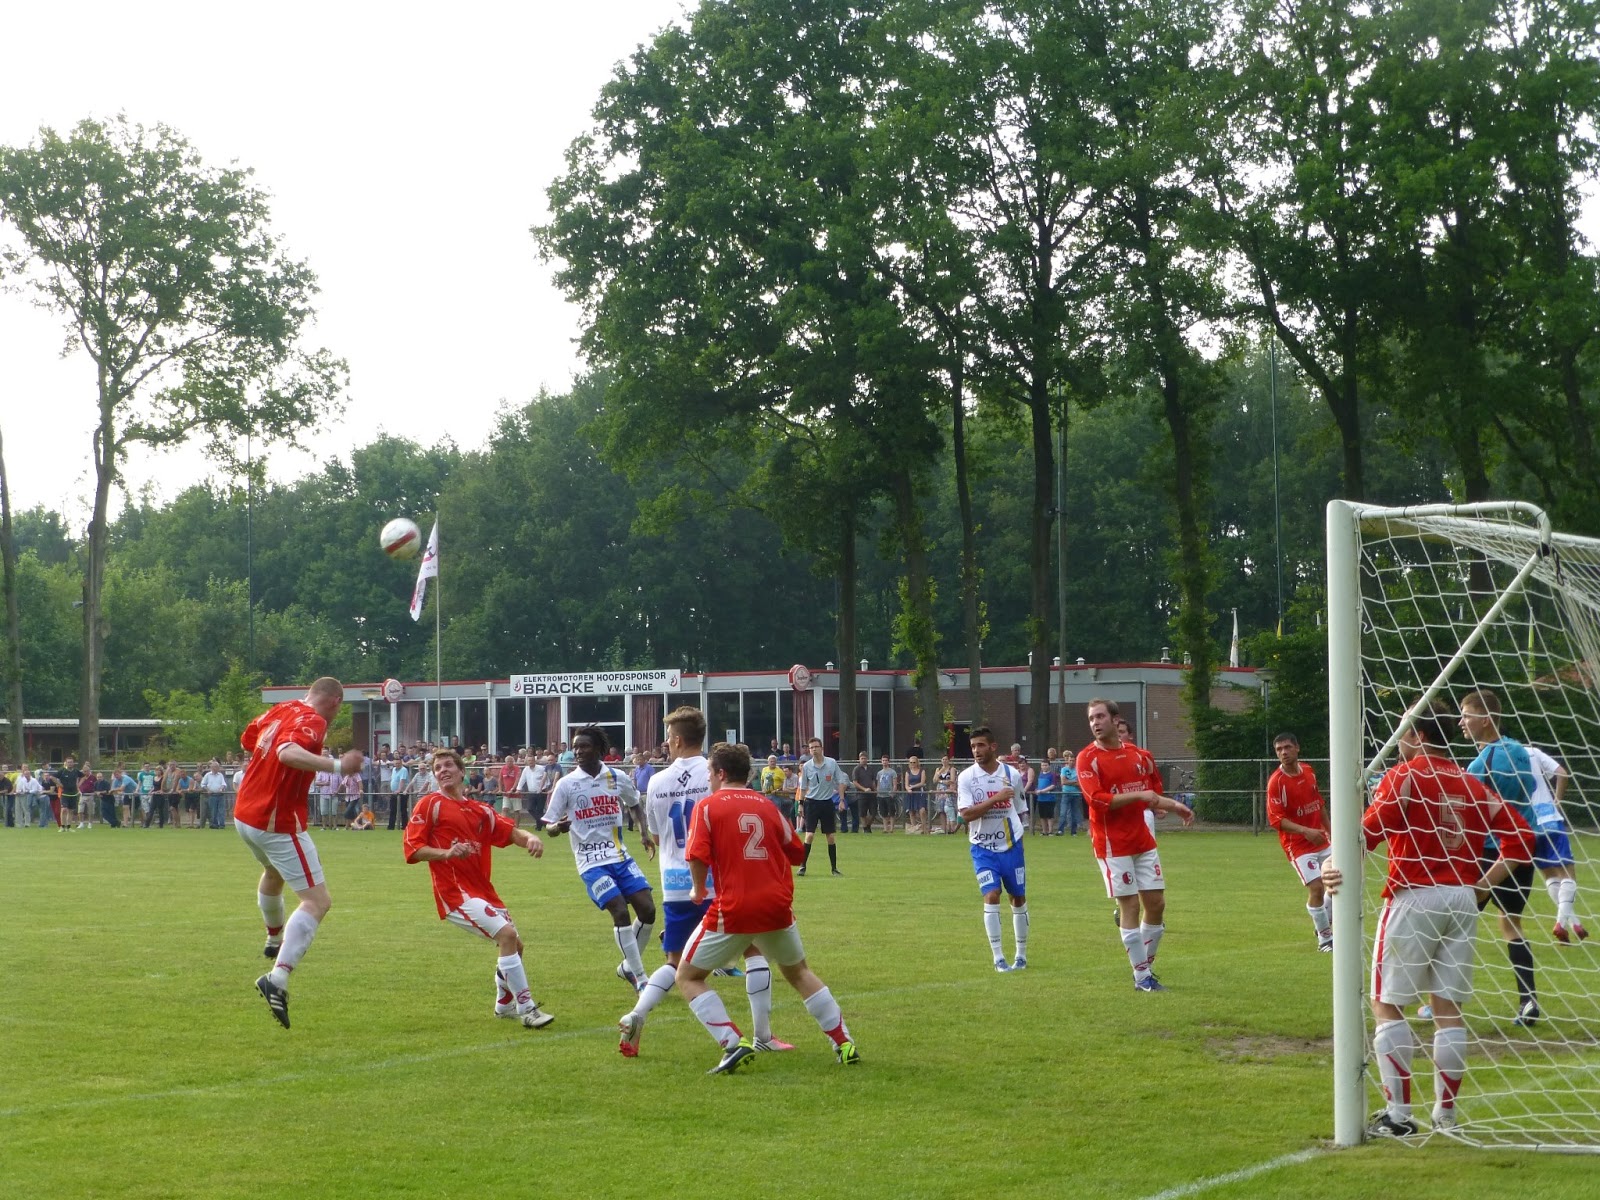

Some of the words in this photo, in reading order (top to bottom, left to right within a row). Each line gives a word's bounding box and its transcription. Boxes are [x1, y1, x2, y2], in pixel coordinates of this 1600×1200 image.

[523, 674, 594, 683] ELEKTROMOTOREN
[596, 671, 666, 681] HOOFDSPONSOR
[523, 682, 595, 694] BRACKE
[1438, 792, 1466, 851] 5
[737, 813, 769, 860] 2
